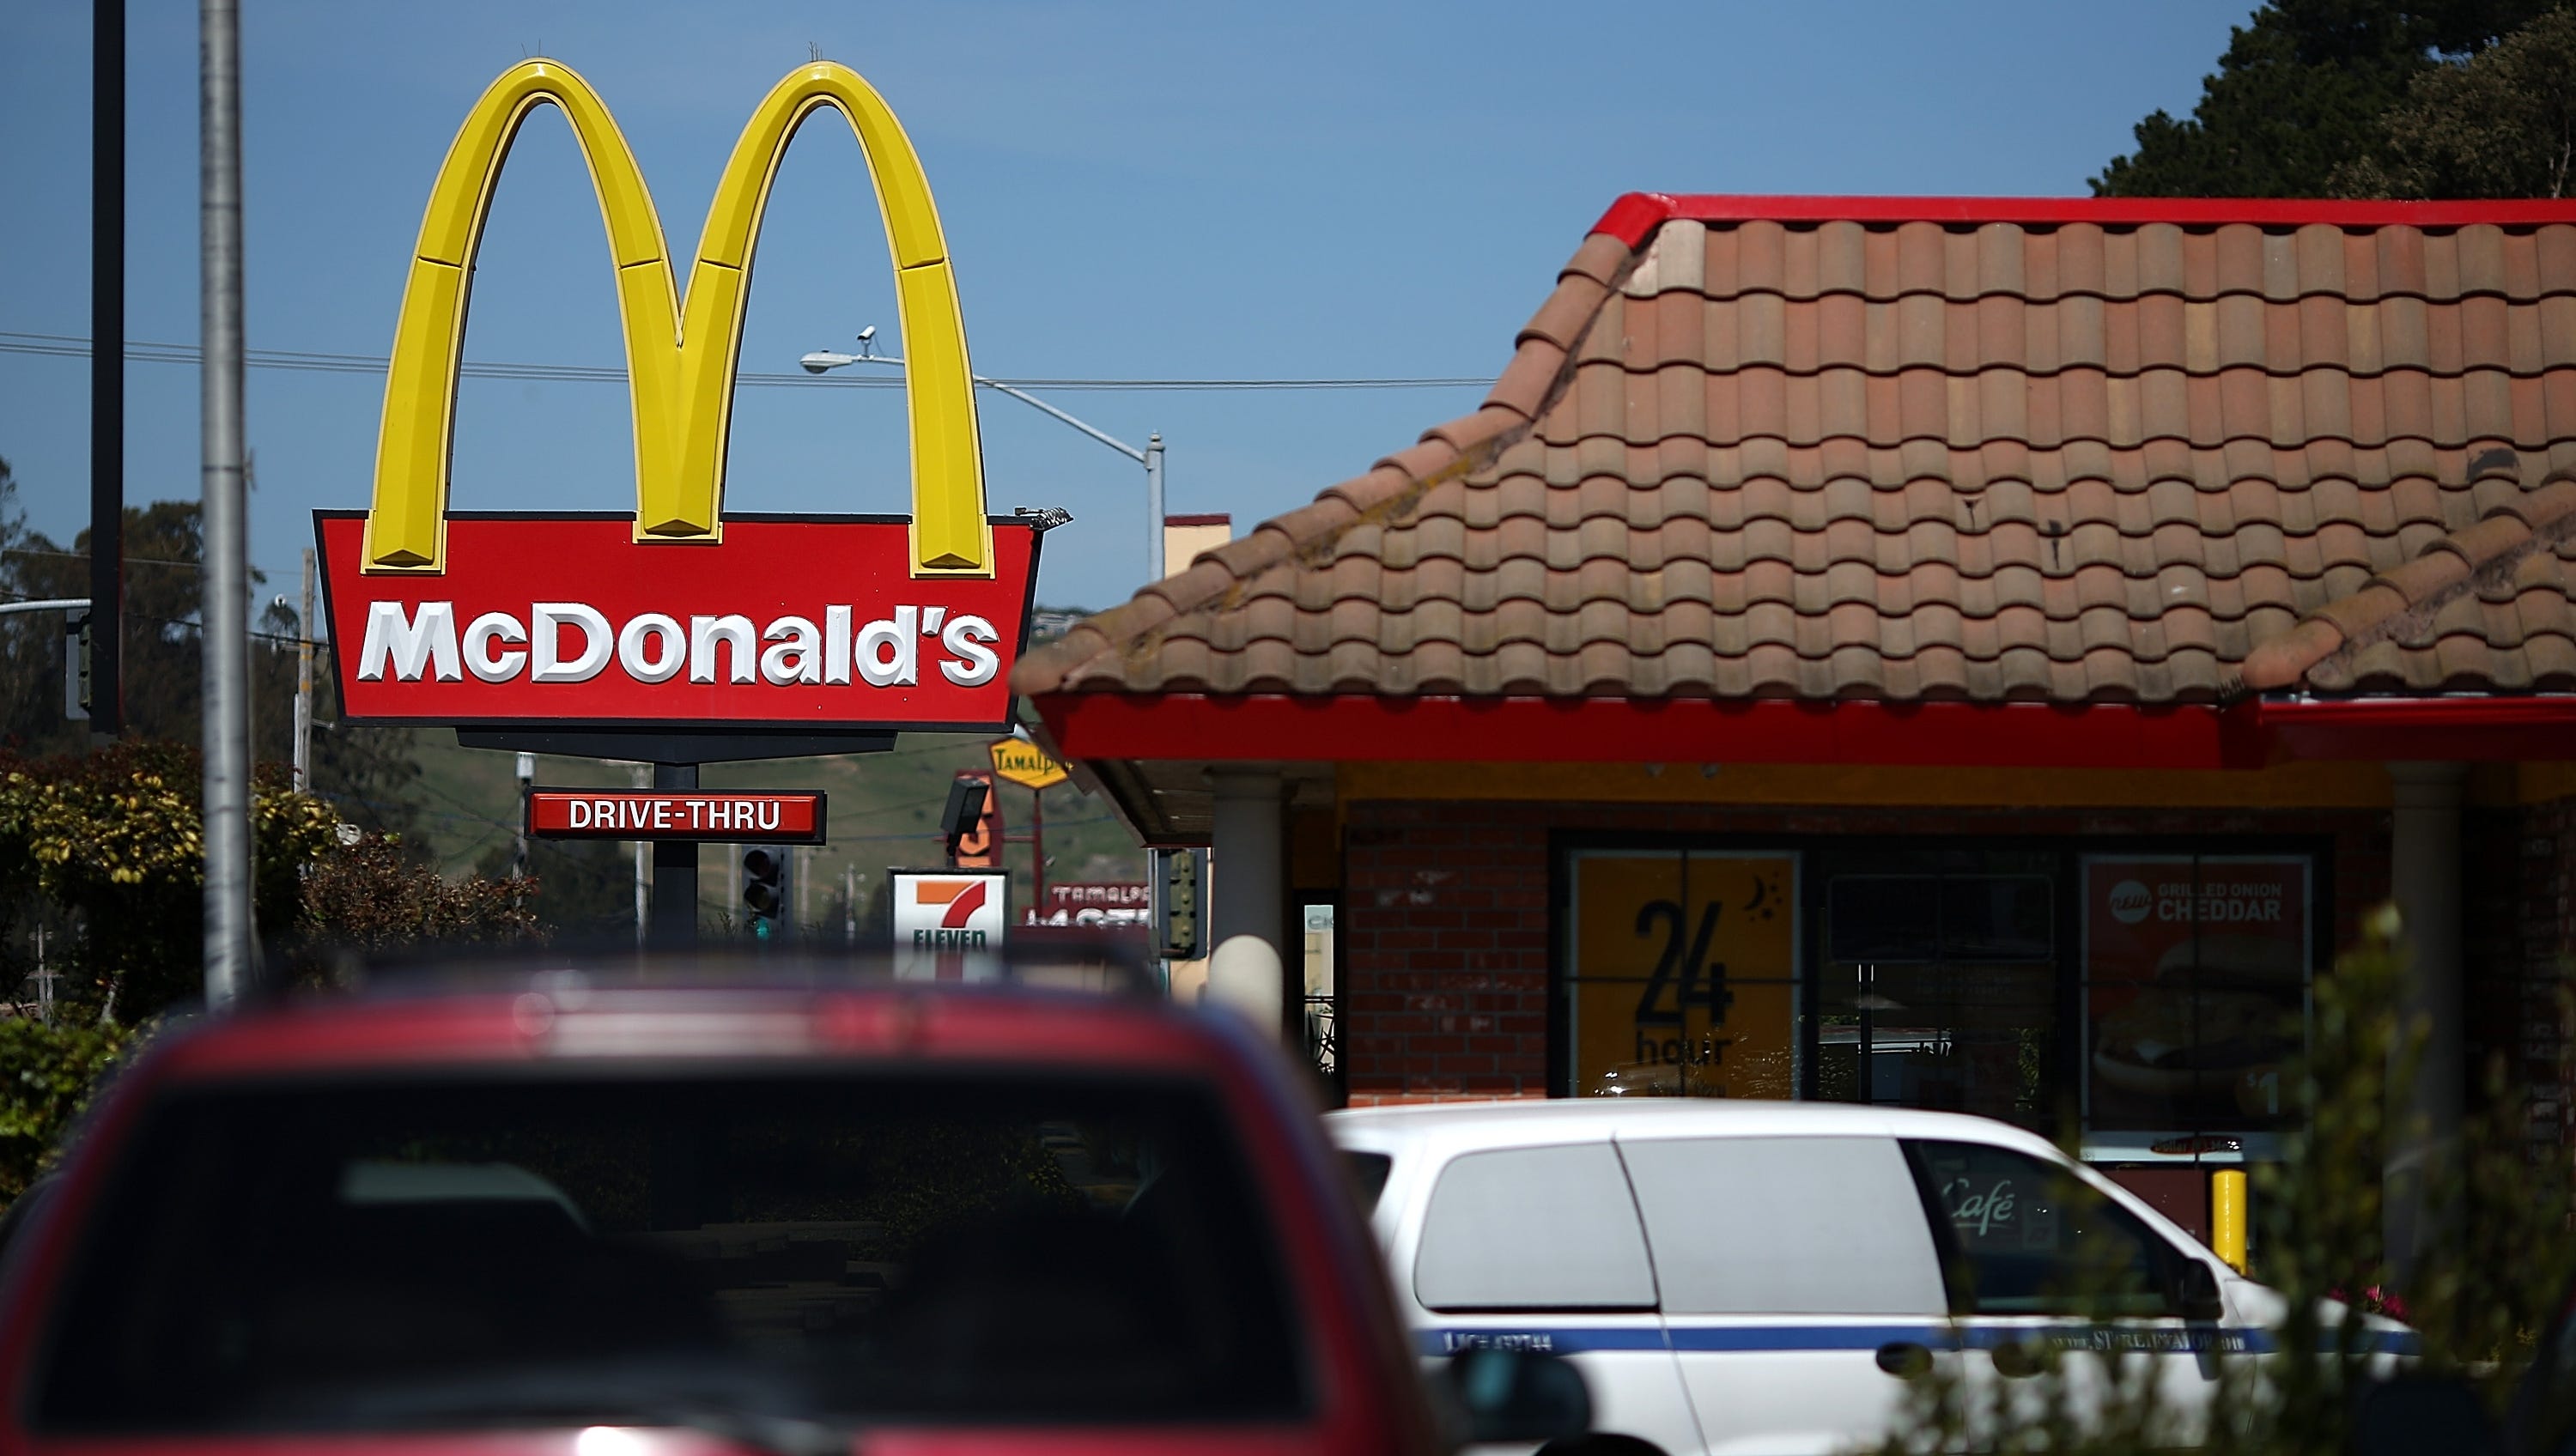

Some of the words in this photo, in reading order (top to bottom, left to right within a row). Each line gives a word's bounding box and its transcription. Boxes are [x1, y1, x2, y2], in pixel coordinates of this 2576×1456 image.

[355, 598, 1002, 689] McDonald's
[568, 798, 781, 831] DRIVE-THRU
[2157, 883, 2227, 897] GRILLED
[2230, 883, 2282, 897] ONION
[2157, 899, 2281, 921] CHEDDAR
[1635, 899, 1735, 1027] 24
[1635, 1029, 1733, 1065] hour
[2246, 1071, 2280, 1115] $1
